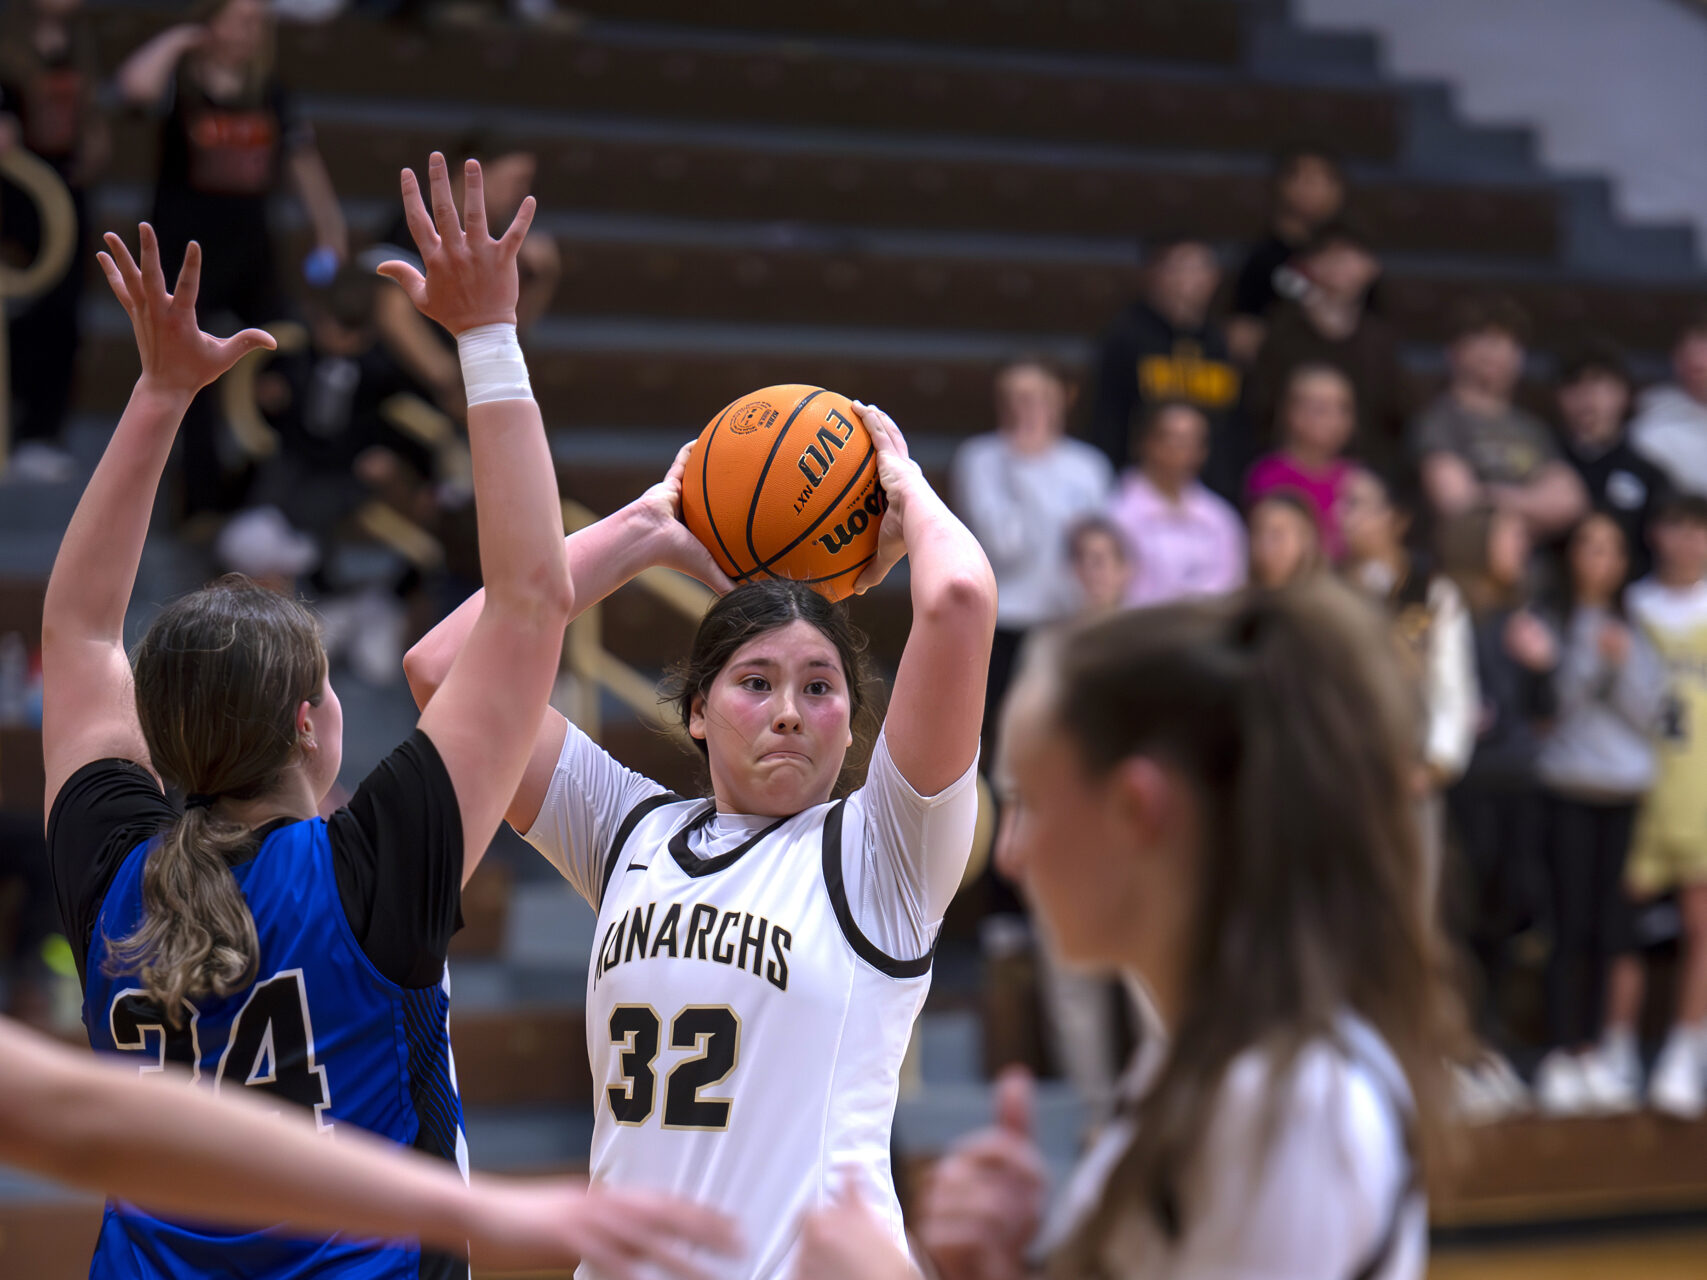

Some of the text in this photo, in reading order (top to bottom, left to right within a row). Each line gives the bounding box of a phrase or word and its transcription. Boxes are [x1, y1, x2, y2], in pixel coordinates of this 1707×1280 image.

[793, 408, 854, 516] EVO NXT
[818, 480, 889, 555] son
[606, 1003, 742, 1132] 32
